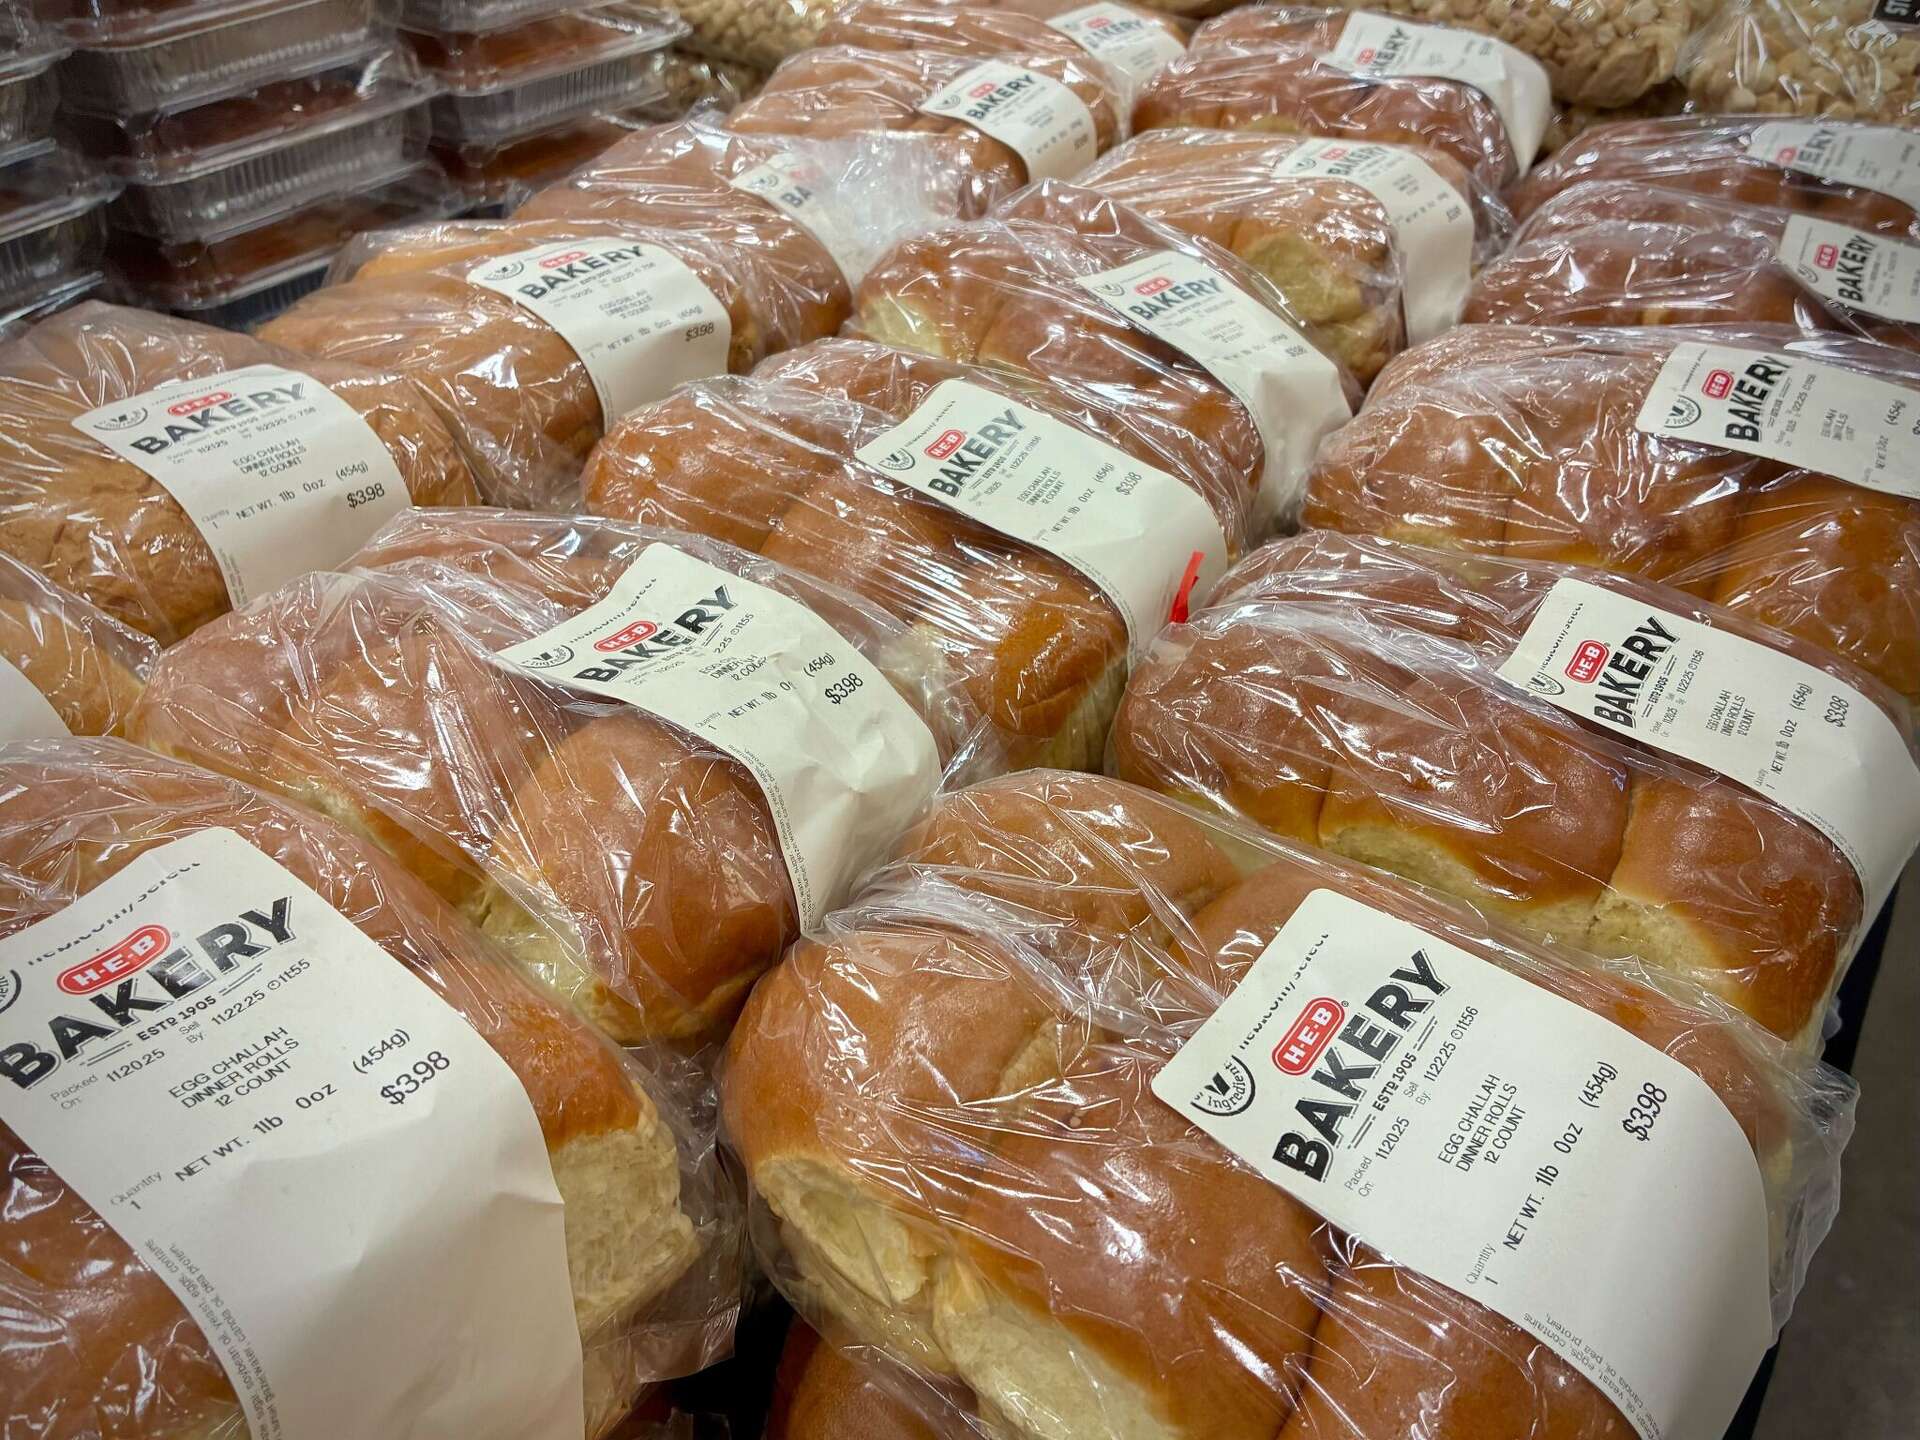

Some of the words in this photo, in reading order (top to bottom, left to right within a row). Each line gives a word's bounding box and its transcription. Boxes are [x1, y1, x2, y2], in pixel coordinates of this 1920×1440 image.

[966, 74, 1036, 120] BAKERY
[518, 245, 645, 300] BAKERY
[1838, 235, 1877, 302] BAKERY
[1129, 277, 1224, 321] BAKERY
[130, 382, 306, 456] BAKERY
[1725, 355, 1792, 443] BAKERY
[928, 408, 1026, 499] BAKERY
[573, 584, 739, 683] BAKERY
[802, 651, 837, 679] (454g)
[1594, 615, 1680, 730] BAKERY
[727, 705, 746, 720] NET
[0, 895, 297, 1091] BAKERY
[178, 994, 218, 1022] 1905
[49, 1073, 99, 1103] Packed
[168, 1072, 211, 1100] EGG
[211, 1025, 290, 1077] CHALLAH
[181, 1071, 244, 1109] DINNER
[244, 1036, 300, 1075] ROLLS
[213, 1091, 232, 1109] 12
[234, 1057, 293, 1097] COUNT
[378, 1049, 452, 1108] $3.98
[1271, 947, 1451, 1184] BAKERY
[1391, 1052, 1417, 1084] 1905
[174, 1153, 214, 1183] NET
[213, 1134, 252, 1160] WT.
[252, 1113, 285, 1137] 1lb
[294, 1082, 340, 1111] 0oz
[352, 1028, 413, 1076] (454g)
[1437, 1132, 1466, 1165] EGG
[1457, 1072, 1502, 1134] CHALLAH
[1455, 1121, 1493, 1173] DINNER
[1488, 1081, 1518, 1127] ROLLS
[1491, 1102, 1527, 1151] COUNT
[1620, 1081, 1669, 1143] $3.98
[1344, 1156, 1373, 1191] Packed
[1483, 1151, 1501, 1166] 12
[1502, 1217, 1530, 1252] NET
[1518, 1192, 1546, 1221] WT.
[1534, 1162, 1560, 1188] 1lb
[1552, 1121, 1585, 1155] 0oz
[1576, 1060, 1620, 1110] (454g)
[130, 1199, 142, 1212] 1
[1464, 1242, 1497, 1286] Quantity
[1484, 1275, 1499, 1286] 1
[1521, 1311, 1567, 1348] contains
[1545, 1312, 1583, 1348] protein,
[1583, 1344, 1605, 1365] pea
